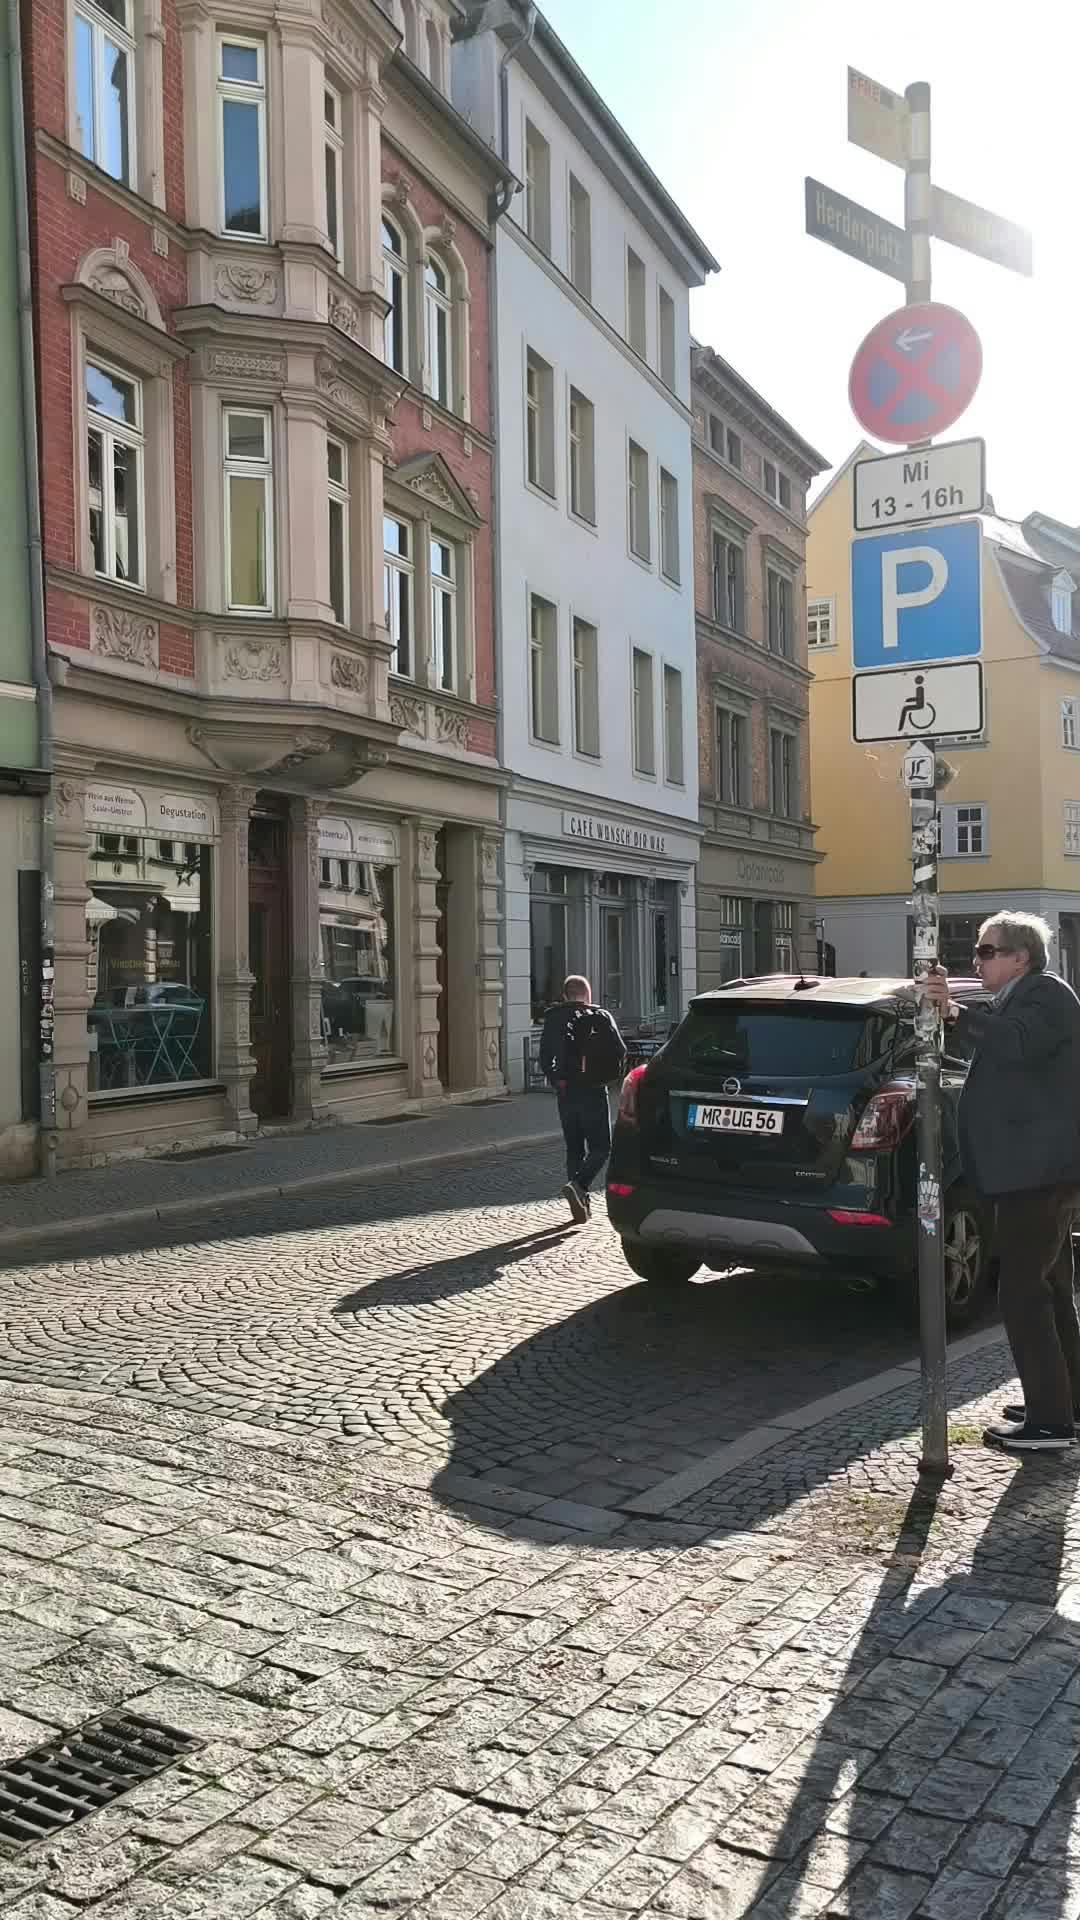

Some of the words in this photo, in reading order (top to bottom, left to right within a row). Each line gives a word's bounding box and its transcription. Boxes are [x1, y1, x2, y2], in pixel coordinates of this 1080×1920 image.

[903, 460, 929, 484] Mi
[872, 496, 896, 518] 13
[920, 485, 963, 511] 16h
[881, 546, 949, 649] P
[160, 804, 206, 820] Degustation
[633, 831, 647, 849] DIR
[650, 835, 665, 852] WAS
[701, 1107, 722, 1126] MR
[732, 1110, 753, 1129] UG
[755, 1111, 776, 1130] 56
